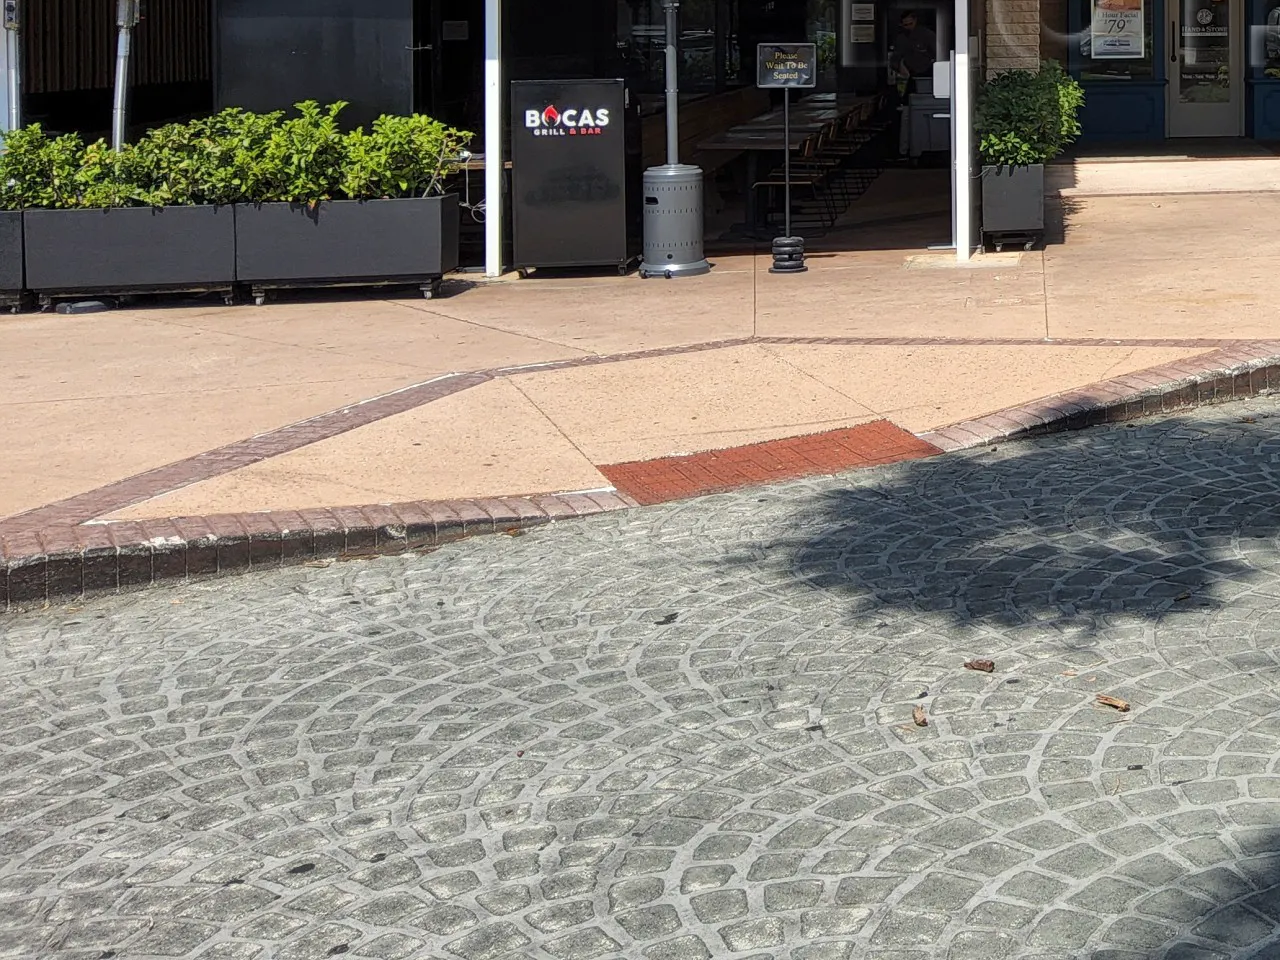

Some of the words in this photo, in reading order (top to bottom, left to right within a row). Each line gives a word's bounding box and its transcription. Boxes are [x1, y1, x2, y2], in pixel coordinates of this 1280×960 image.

[1102, 11, 1118, 19] Hour
[1119, 11, 1139, 19] Facial
[774, 51, 798, 61] Please
[765, 61, 785, 70] Wait
[785, 61, 796, 70] To
[796, 61, 808, 70] Be
[773, 71, 798, 80] Seated
[525, 105, 610, 128] BOCAS
[533, 128, 566, 136] GRILL
[580, 127, 602, 135] BAR
